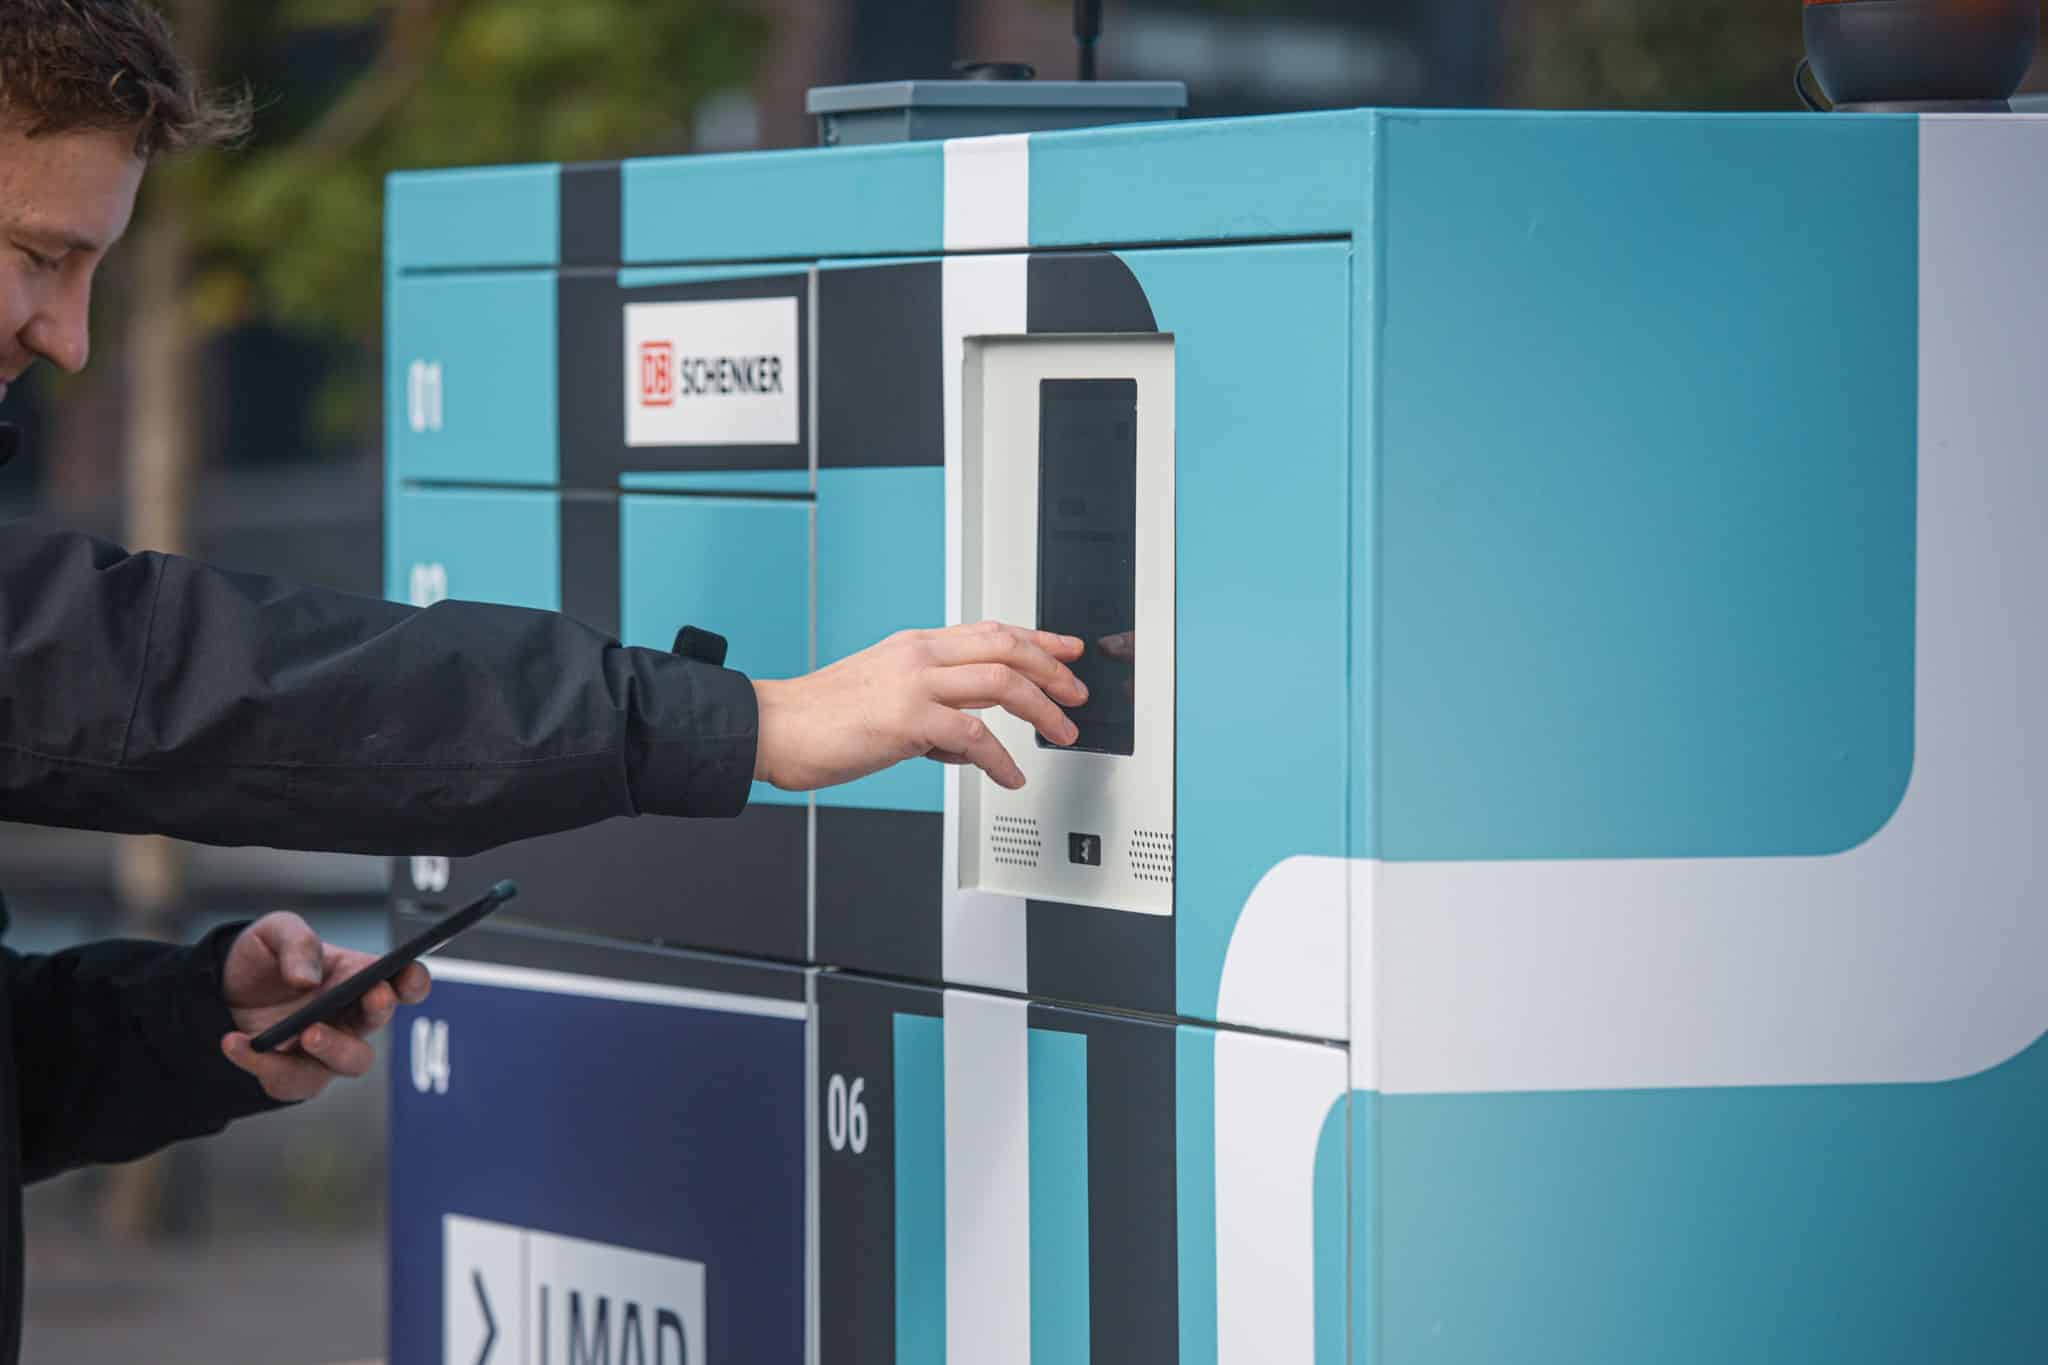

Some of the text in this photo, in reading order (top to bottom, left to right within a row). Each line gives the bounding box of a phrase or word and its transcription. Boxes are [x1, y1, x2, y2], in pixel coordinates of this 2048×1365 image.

[408, 359, 443, 432] 01
[641, 352, 783, 397] DB SCHENKER
[411, 1017, 449, 1094] 04
[828, 1073, 868, 1154] 06
